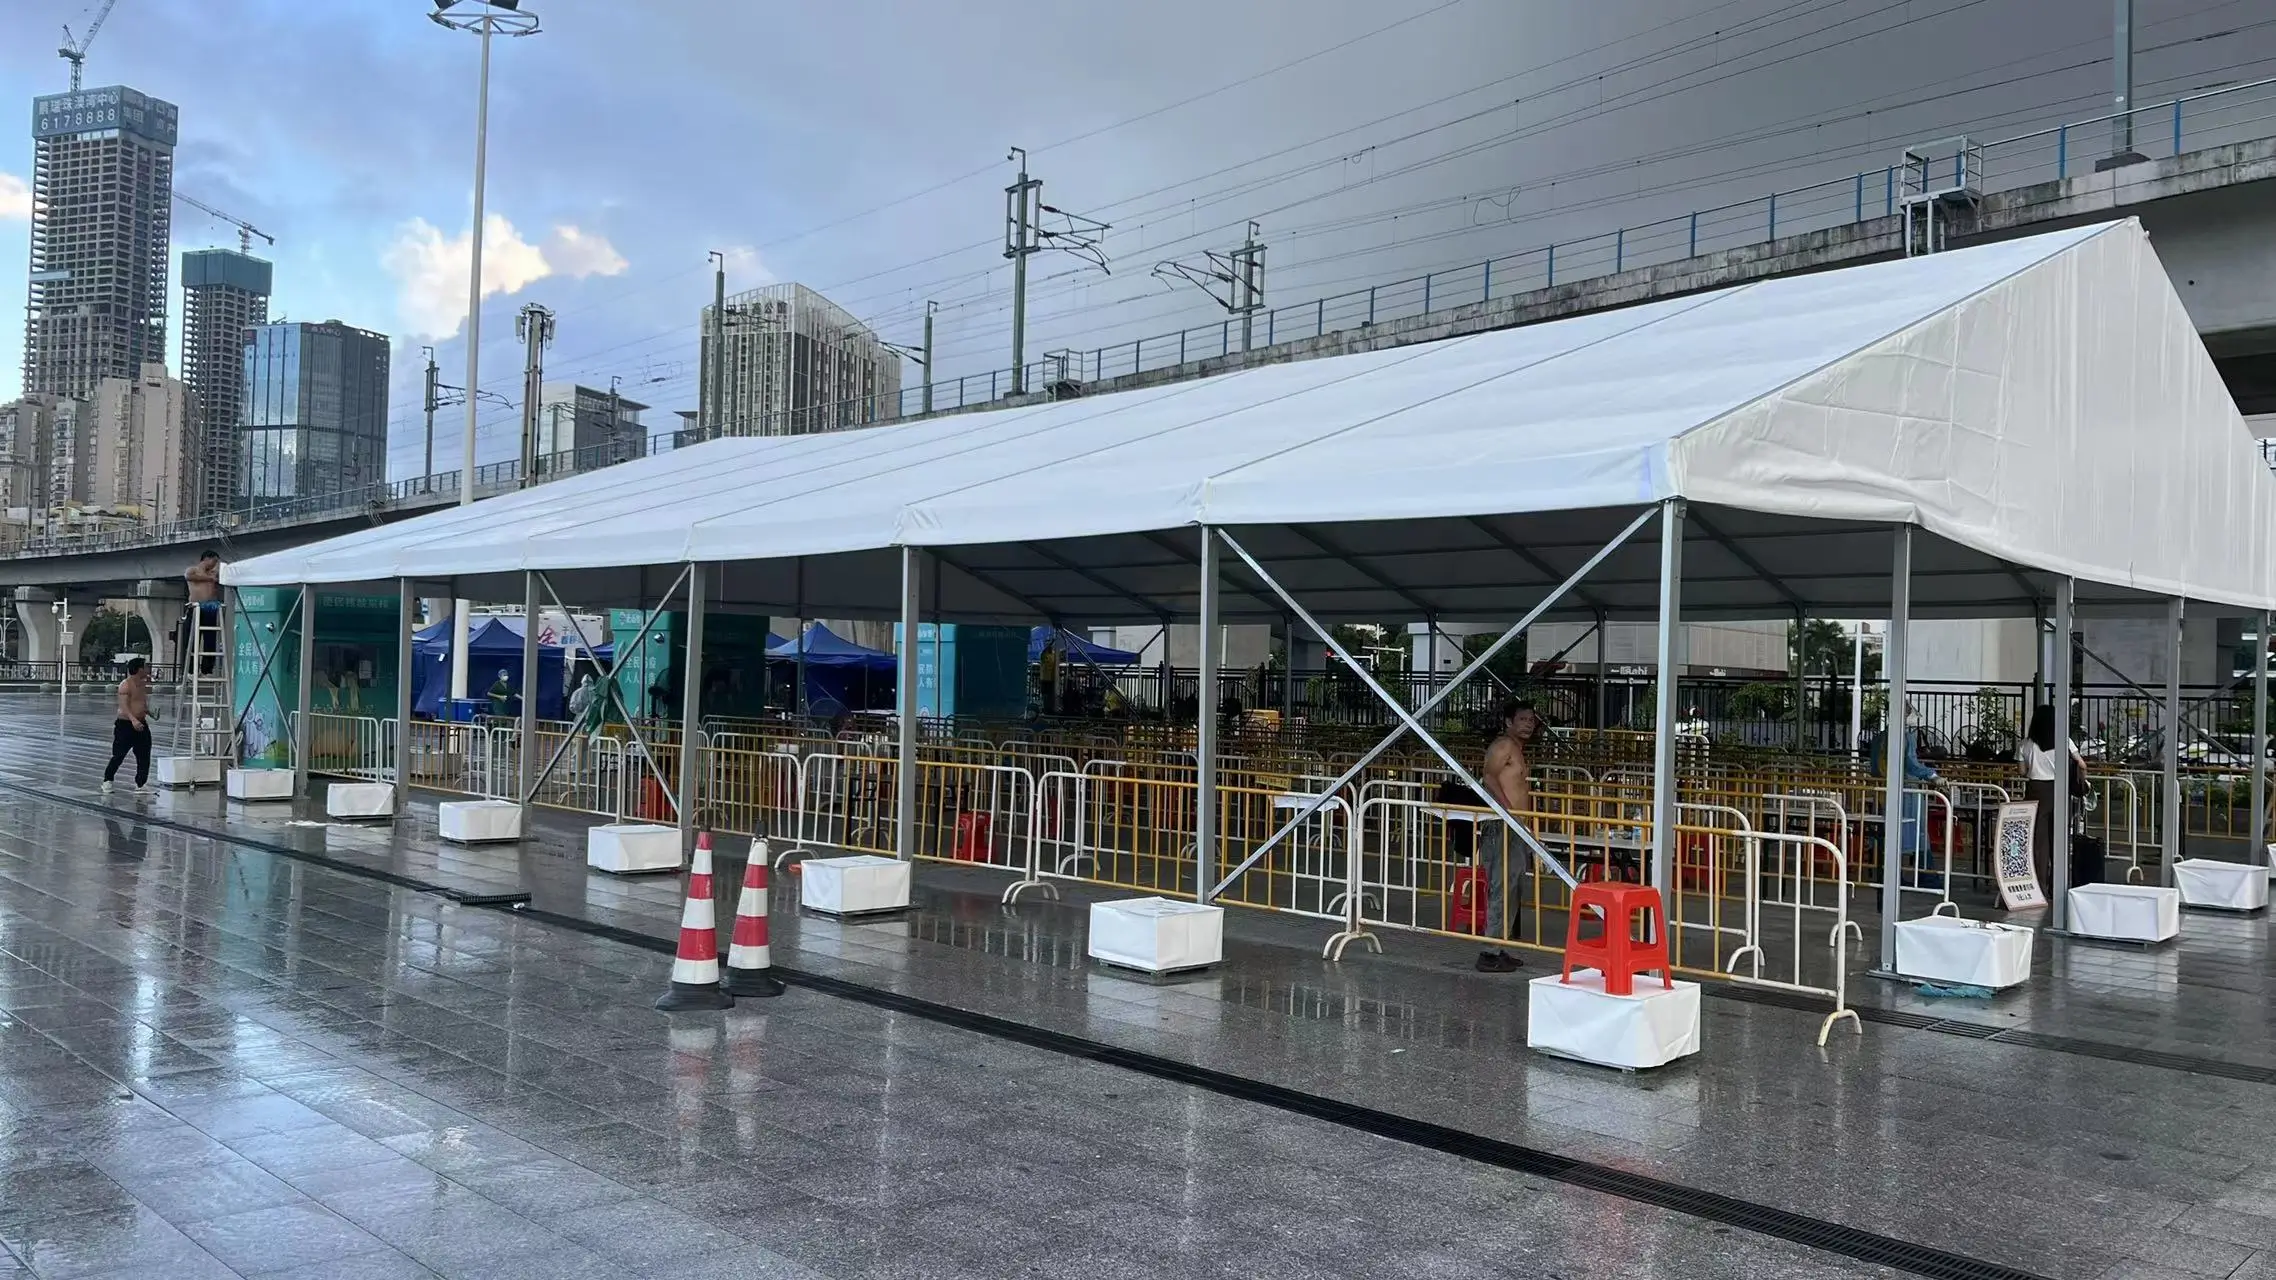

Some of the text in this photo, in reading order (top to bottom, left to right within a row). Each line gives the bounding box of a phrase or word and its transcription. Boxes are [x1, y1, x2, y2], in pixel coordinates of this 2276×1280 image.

[41, 108, 115, 130] 6178888
[624, 671, 656, 685] 人人责
